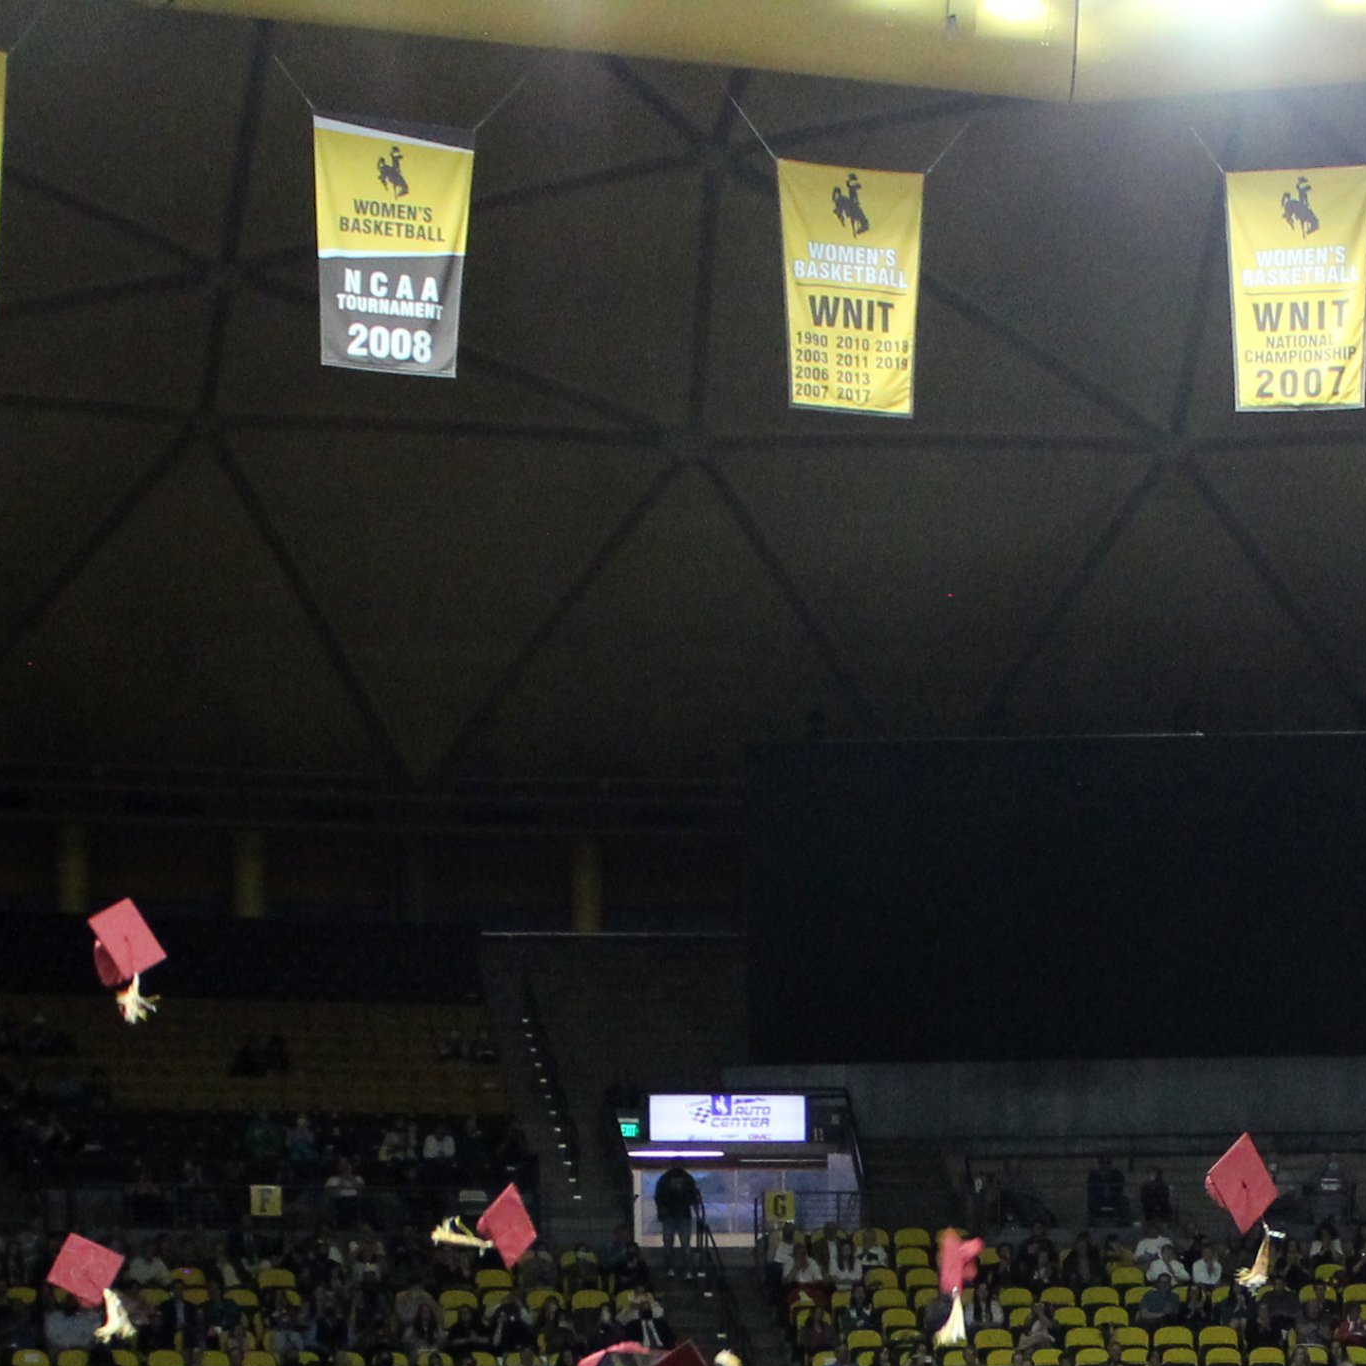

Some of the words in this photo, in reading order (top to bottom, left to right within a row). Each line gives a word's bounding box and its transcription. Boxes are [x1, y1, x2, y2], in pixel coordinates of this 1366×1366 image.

[353, 199, 432, 223] WOMEN'S
[339, 217, 445, 242] BASKETBALL
[808, 242, 896, 267] WOMEN'S
[1255, 246, 1346, 267] WOMEN'S
[794, 260, 908, 289] BASKETBALL
[1242, 264, 1359, 287] BASKETBALL
[336, 294, 443, 320] TOURNAMENT
[808, 295, 894, 333] WNIT
[1252, 299, 1349, 332] WNIT
[347, 323, 432, 364] 2008
[797, 331, 828, 348] 1990
[836, 335, 870, 352] 2010
[876, 339, 908, 354] 2018
[1266, 335, 1334, 349] NATIONAL
[795, 348, 828, 363] 2003
[836, 353, 868, 368] 2011
[876, 357, 908, 371] 2019
[1244, 346, 1356, 364] CHAMPIONSHIP
[795, 366, 828, 381] 2006
[836, 371, 870, 385] 2013
[1255, 366, 1346, 399] 2007
[795, 383, 829, 399] 2007
[837, 388, 871, 403] 2017
[735, 1106, 771, 1115] AUTO
[711, 1117, 770, 1128] CENTER
[774, 1194, 787, 1218] G
